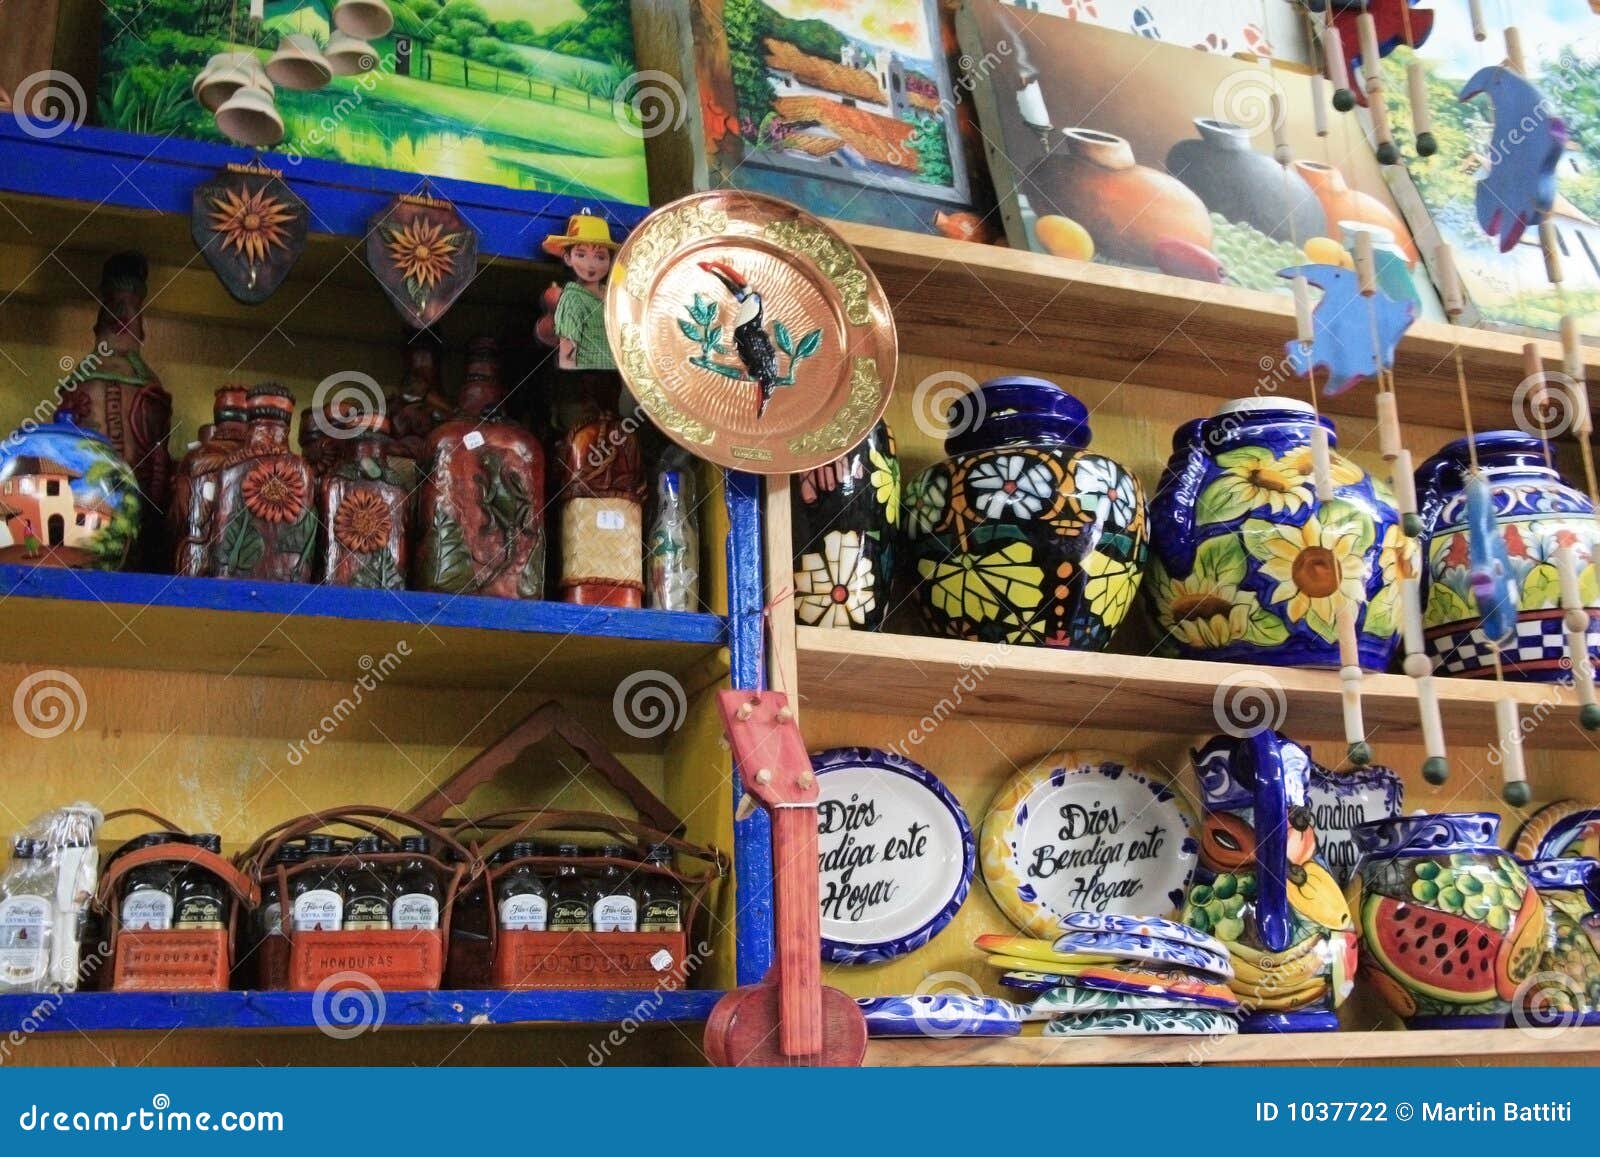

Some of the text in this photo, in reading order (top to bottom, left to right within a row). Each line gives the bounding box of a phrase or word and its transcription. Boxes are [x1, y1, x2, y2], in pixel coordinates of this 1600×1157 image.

[817, 793, 882, 834] Dios
[1058, 800, 1126, 841] Dios
[879, 821, 930, 862] este
[1027, 824, 1167, 879] Bendiga este
[820, 878, 899, 921] Hogar
[1068, 876, 1143, 913] Hogar
[320, 955, 394, 969] HONDURAS
[524, 953, 655, 973] HONDURA
